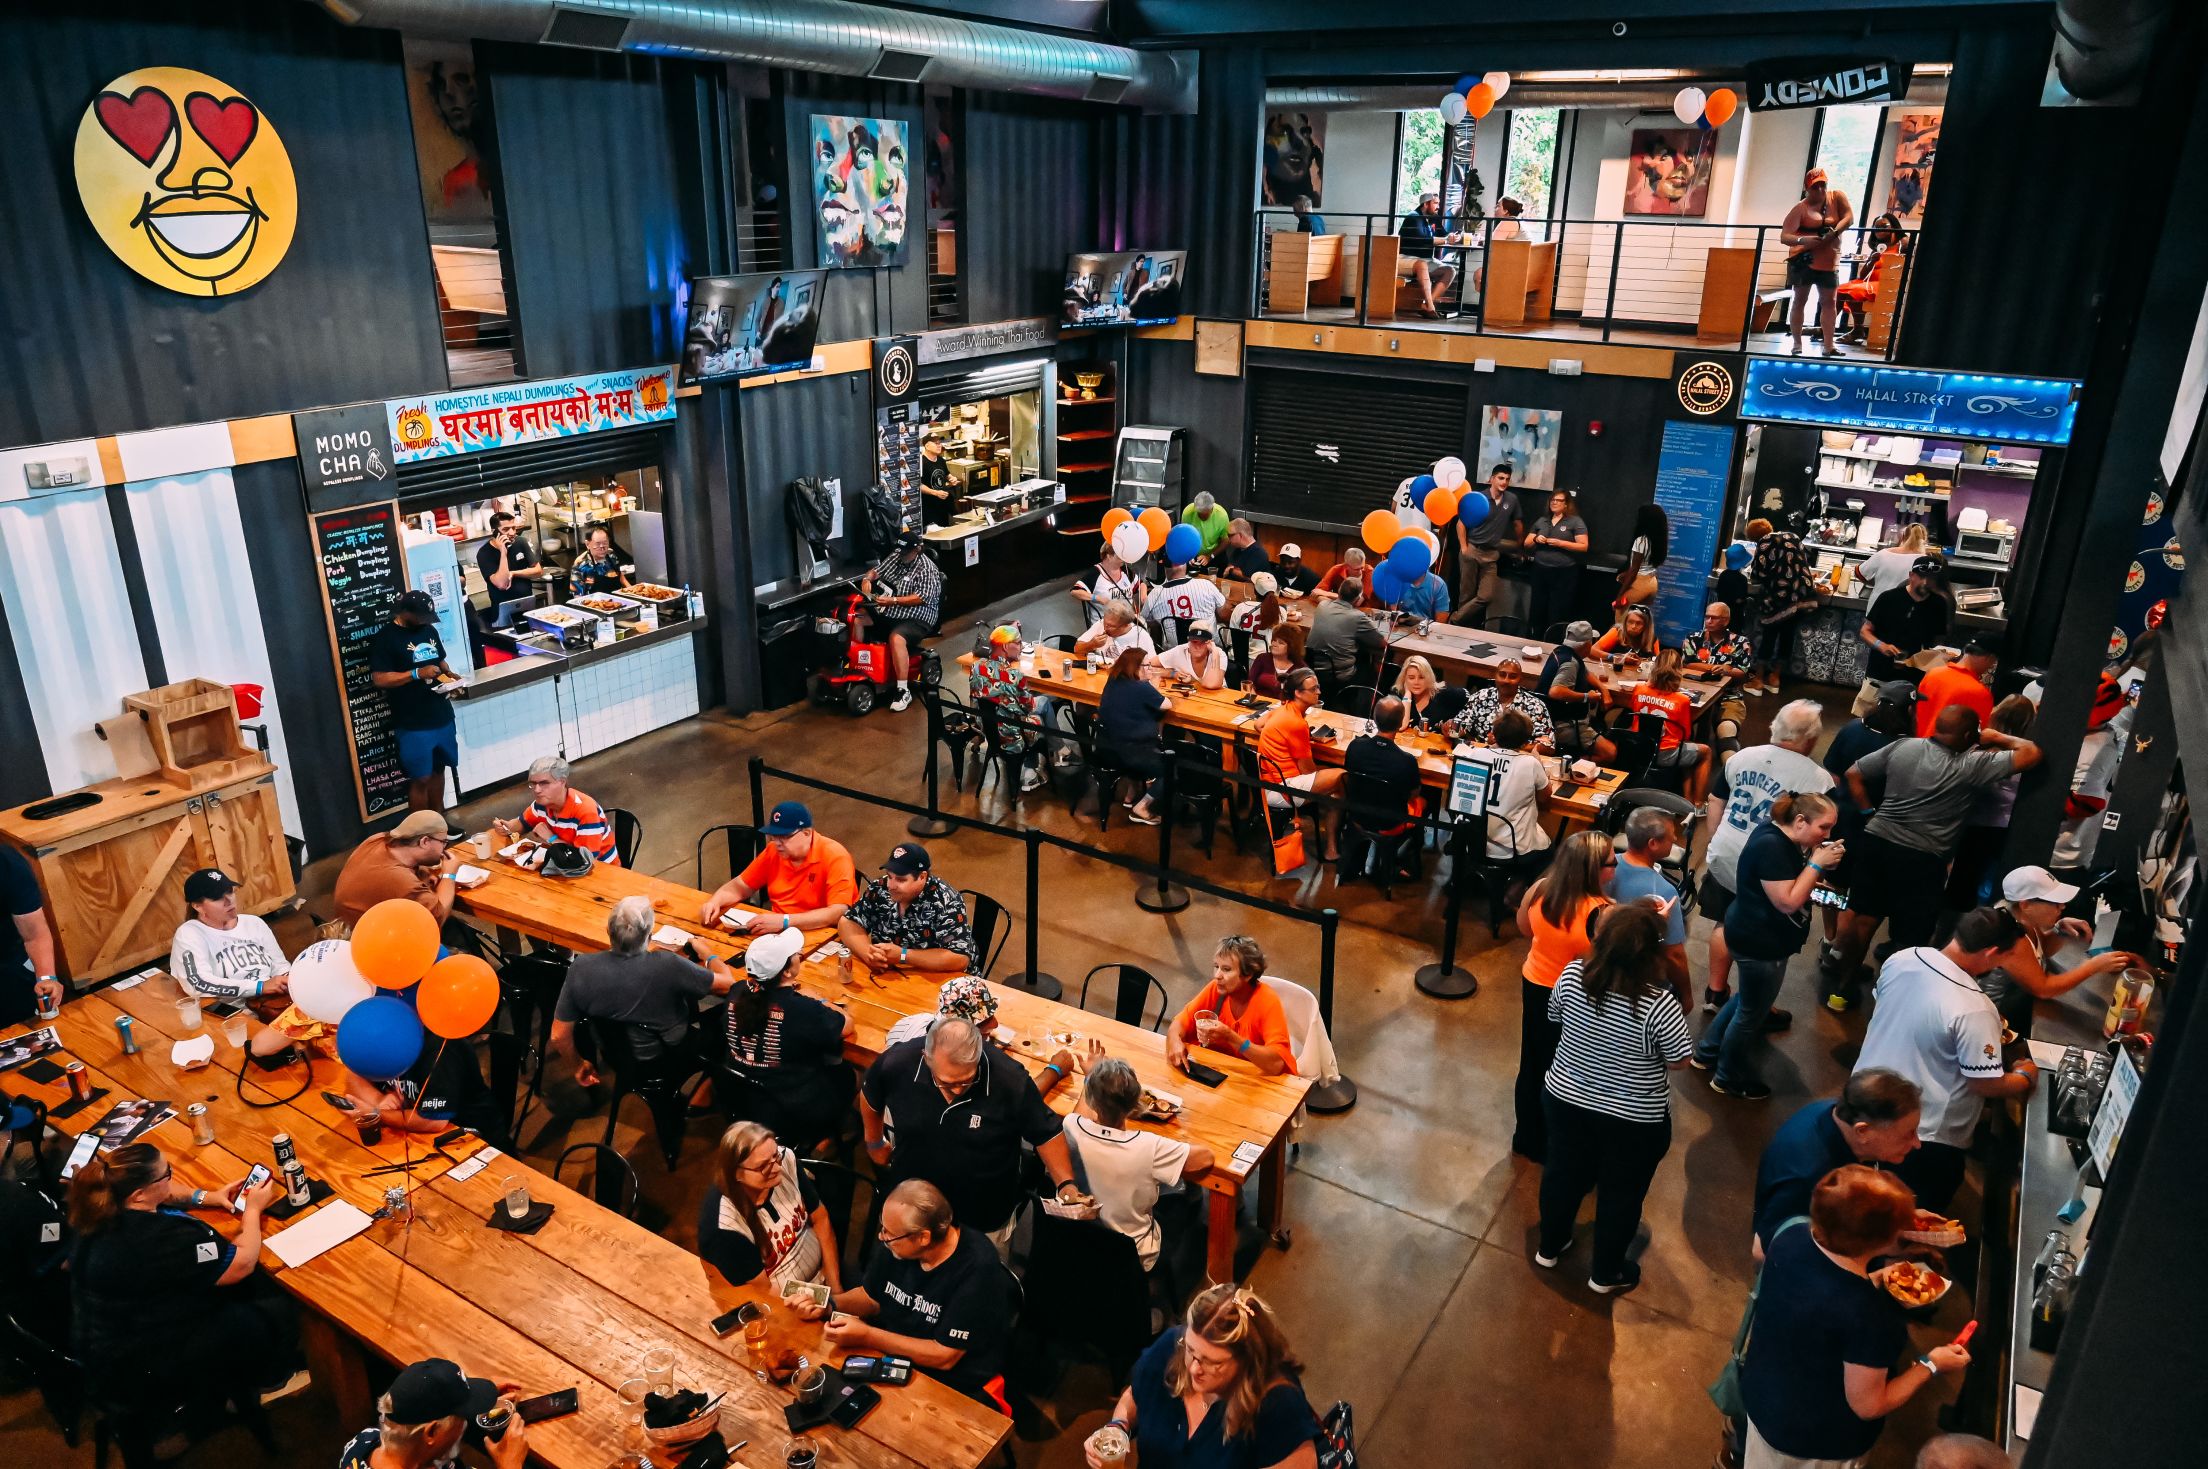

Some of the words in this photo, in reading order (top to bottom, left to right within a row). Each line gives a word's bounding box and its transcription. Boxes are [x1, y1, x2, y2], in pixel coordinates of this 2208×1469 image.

[1759, 64, 1889, 107] COMEDY
[1006, 330, 1023, 344] Thai
[1025, 328, 1045, 341] Food
[635, 370, 671, 393] Welcome
[435, 394, 490, 412] HOMESTYLE
[492, 389, 523, 404] NEPALI
[525, 383, 575, 400] DUMPLINGS
[602, 375, 633, 390] SNACKS
[1856, 388, 1898, 402] HALAL
[1904, 391, 1954, 407] STREET
[396, 400, 428, 424] Fresh
[315, 430, 372, 454] MOMO
[394, 437, 440, 453] DUMPLINGS
[320, 454, 362, 476] CHA
[323, 551, 356, 565] Chicken
[355, 546, 388, 557] Dumplings
[326, 565, 345, 577] Pork
[357, 556, 390, 567] Dumplings
[328, 576, 352, 586] Veggie
[360, 568, 391, 579] Dumplings
[1168, 595, 1194, 619] 19
[1637, 694, 1676, 711] BROOKENS
[1493, 758, 1510, 773] VIC
[1735, 770, 1783, 798] CABRER
[1728, 788, 1774, 832] 24
[948, 1328, 970, 1340] DTE
